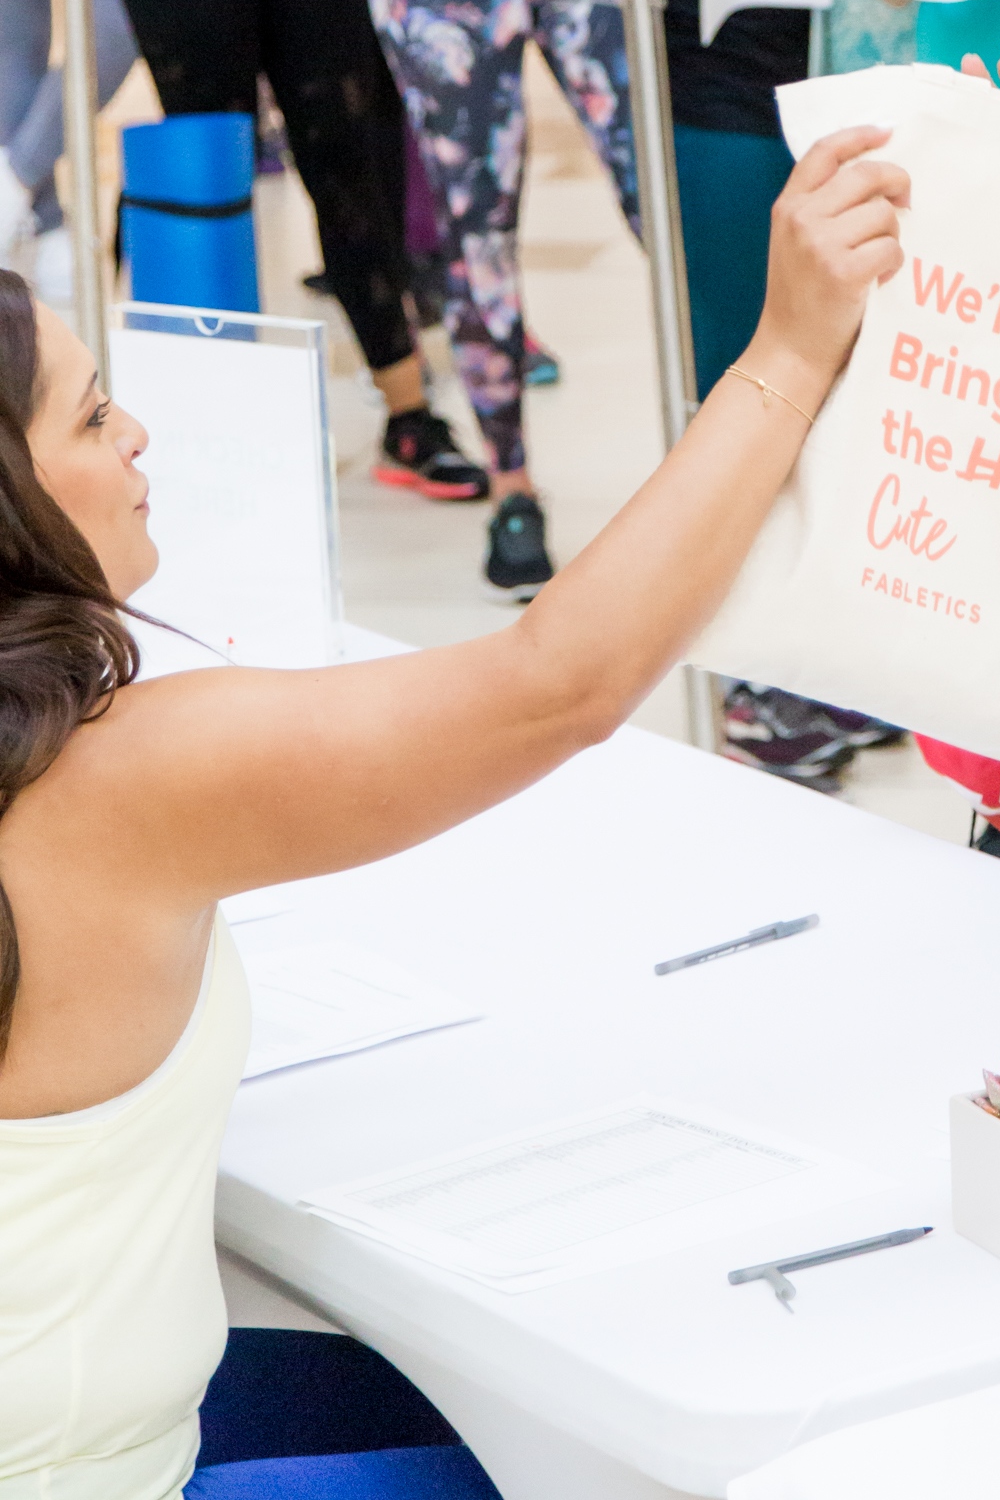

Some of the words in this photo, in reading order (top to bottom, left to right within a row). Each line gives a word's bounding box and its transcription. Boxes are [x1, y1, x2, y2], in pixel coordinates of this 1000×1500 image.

[881, 409, 953, 473] the
[867, 473, 958, 562] Cute
[861, 567, 982, 625] FABLETICS
